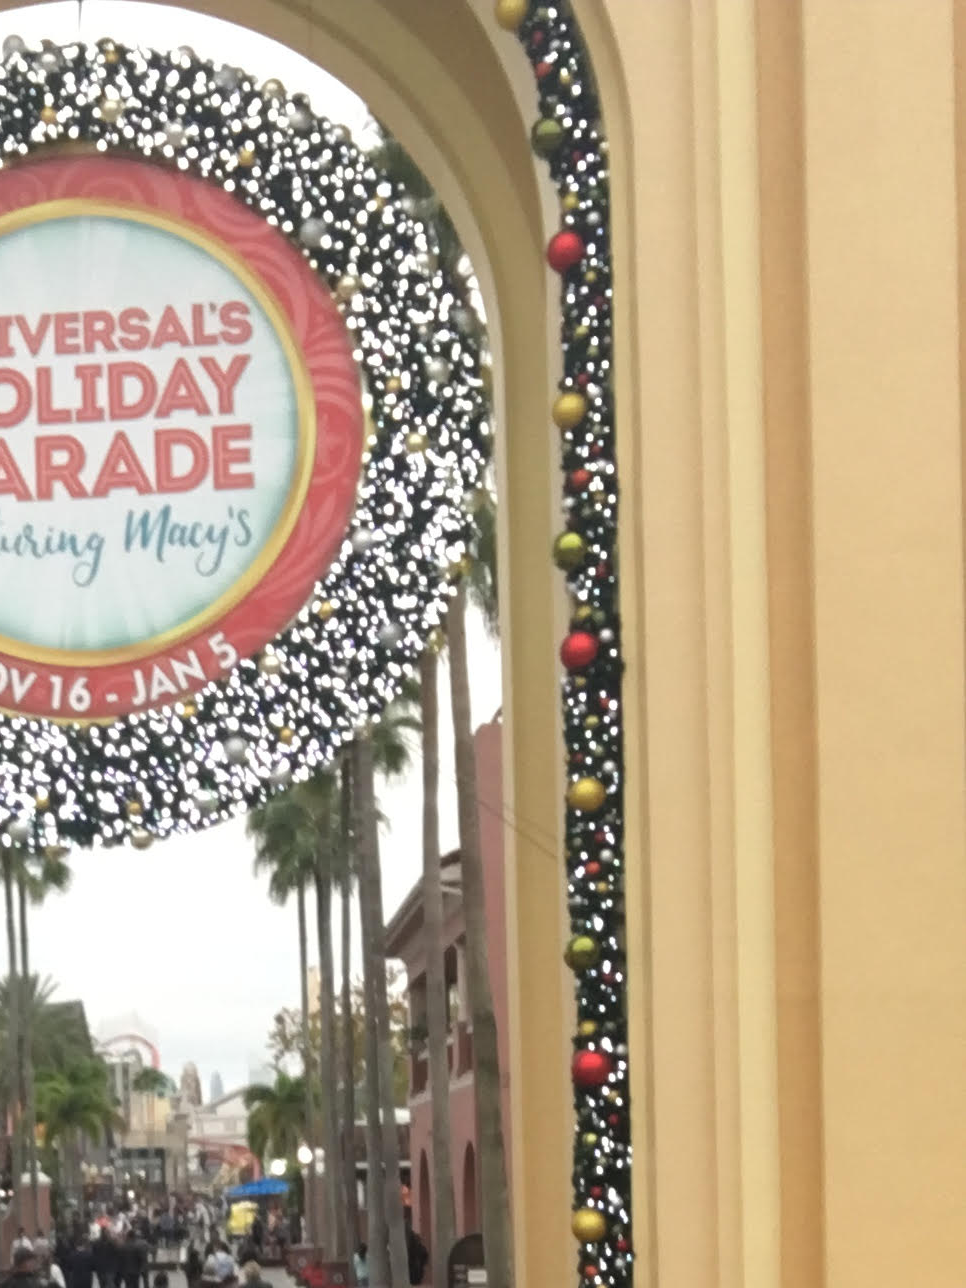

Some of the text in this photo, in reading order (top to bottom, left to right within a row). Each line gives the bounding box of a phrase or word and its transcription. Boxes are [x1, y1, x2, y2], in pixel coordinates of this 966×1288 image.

[123, 504, 253, 577] Macy's
[49, 675, 92, 712] 16
[132, 649, 207, 706] JAN
[207, 632, 239, 669] 5
